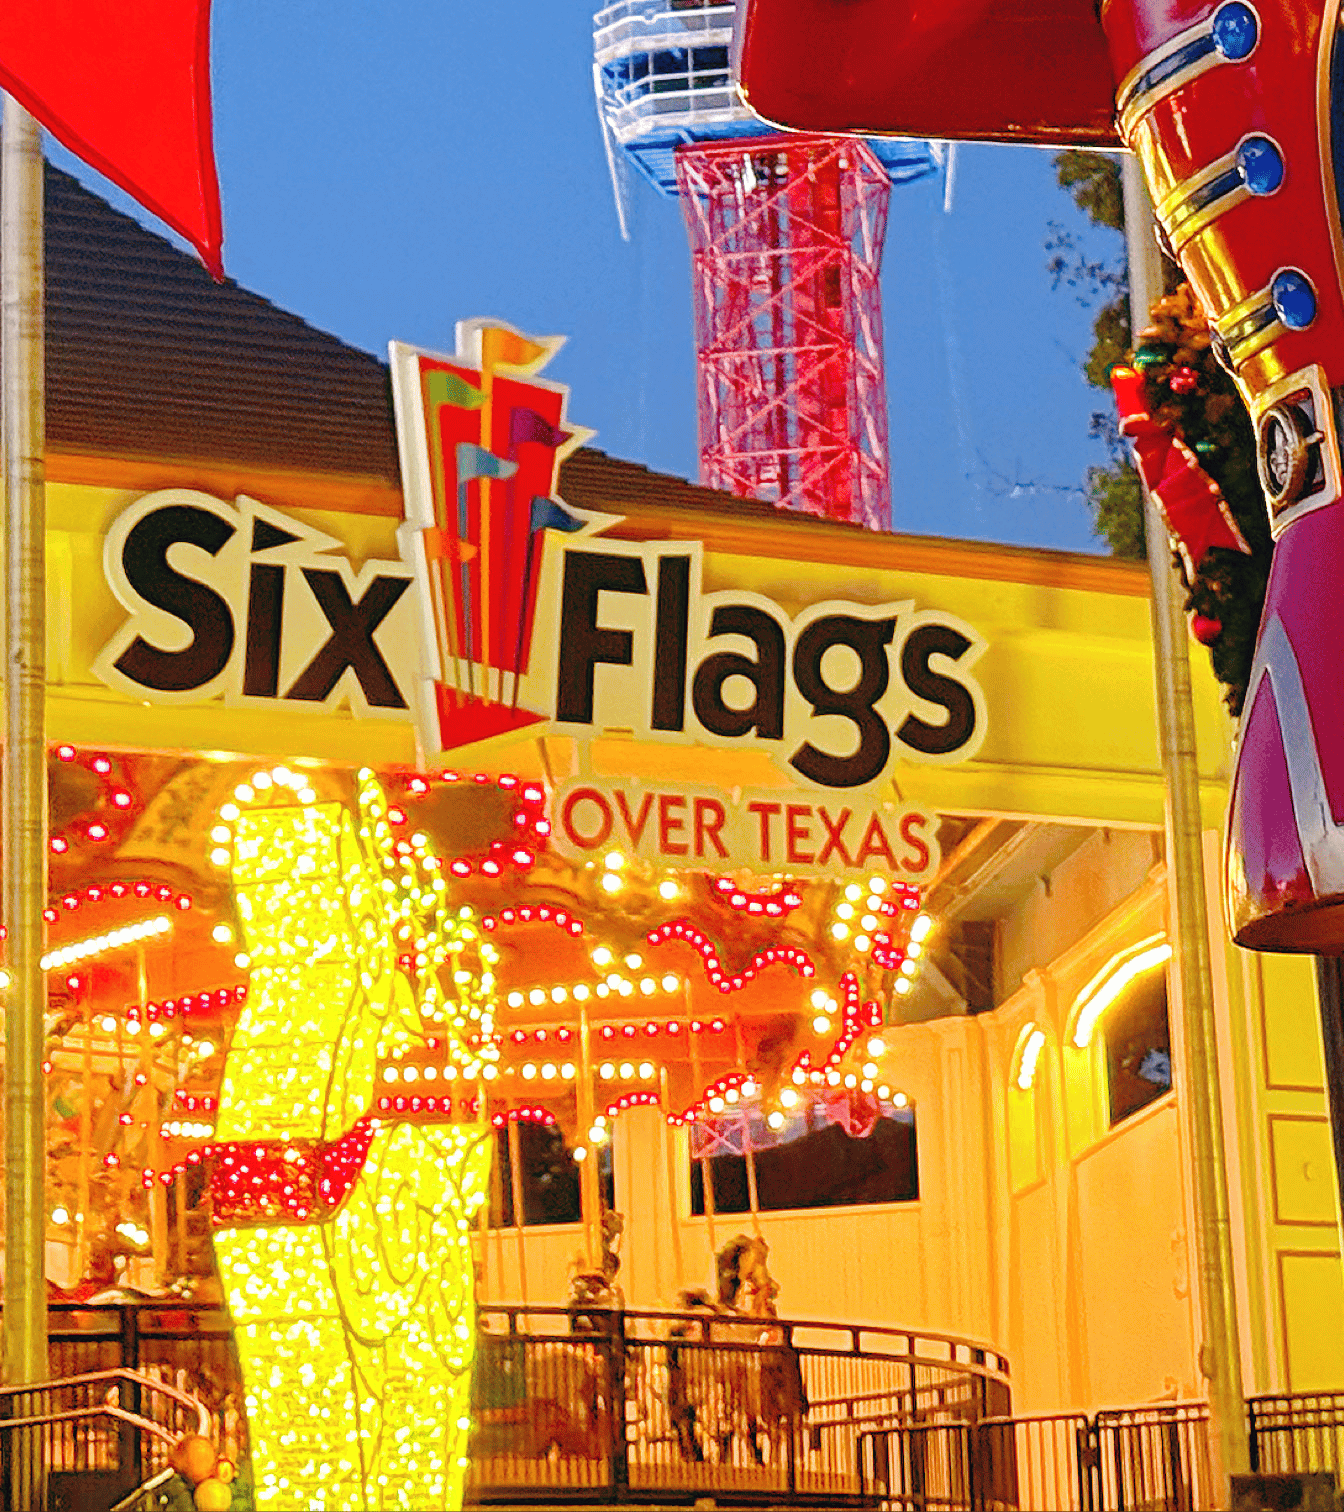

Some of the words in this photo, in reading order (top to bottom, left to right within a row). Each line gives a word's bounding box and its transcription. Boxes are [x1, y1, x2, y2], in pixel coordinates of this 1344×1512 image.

[114, 503, 414, 711] Six
[555, 549, 978, 788] Flags
[561, 787, 731, 859] OVER
[747, 800, 930, 874] TEXAS
